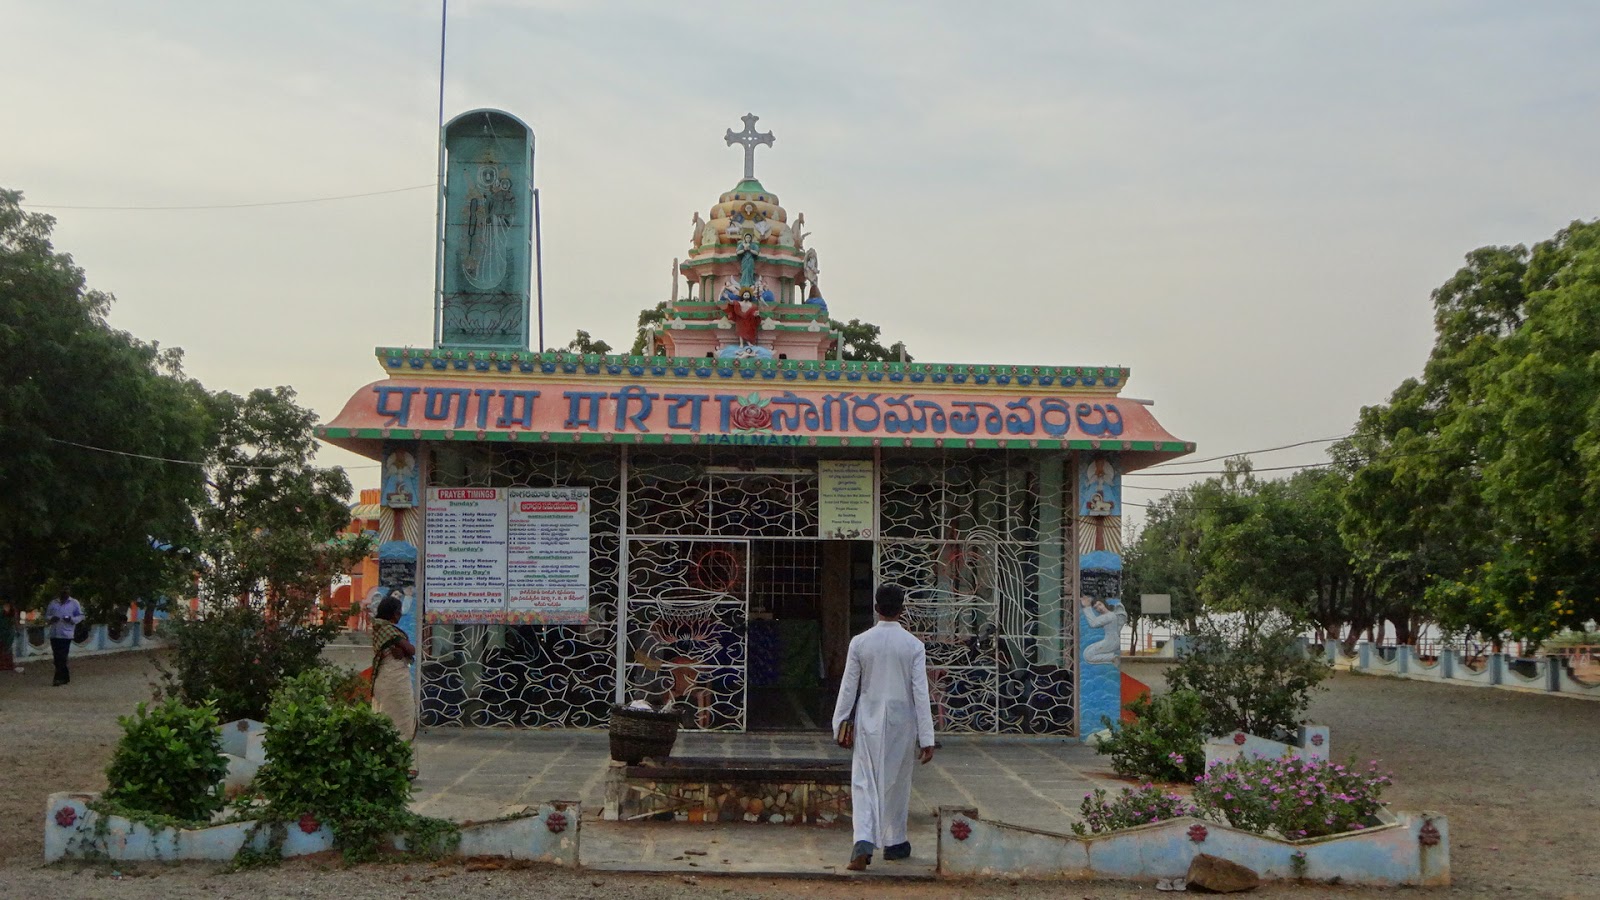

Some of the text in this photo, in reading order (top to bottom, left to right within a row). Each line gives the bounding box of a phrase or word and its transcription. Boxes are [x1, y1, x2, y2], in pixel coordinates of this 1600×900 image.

[372, 385, 738, 433] प्रणाम मरिया
[440, 490, 494, 498] PRAYER TIMINGS
